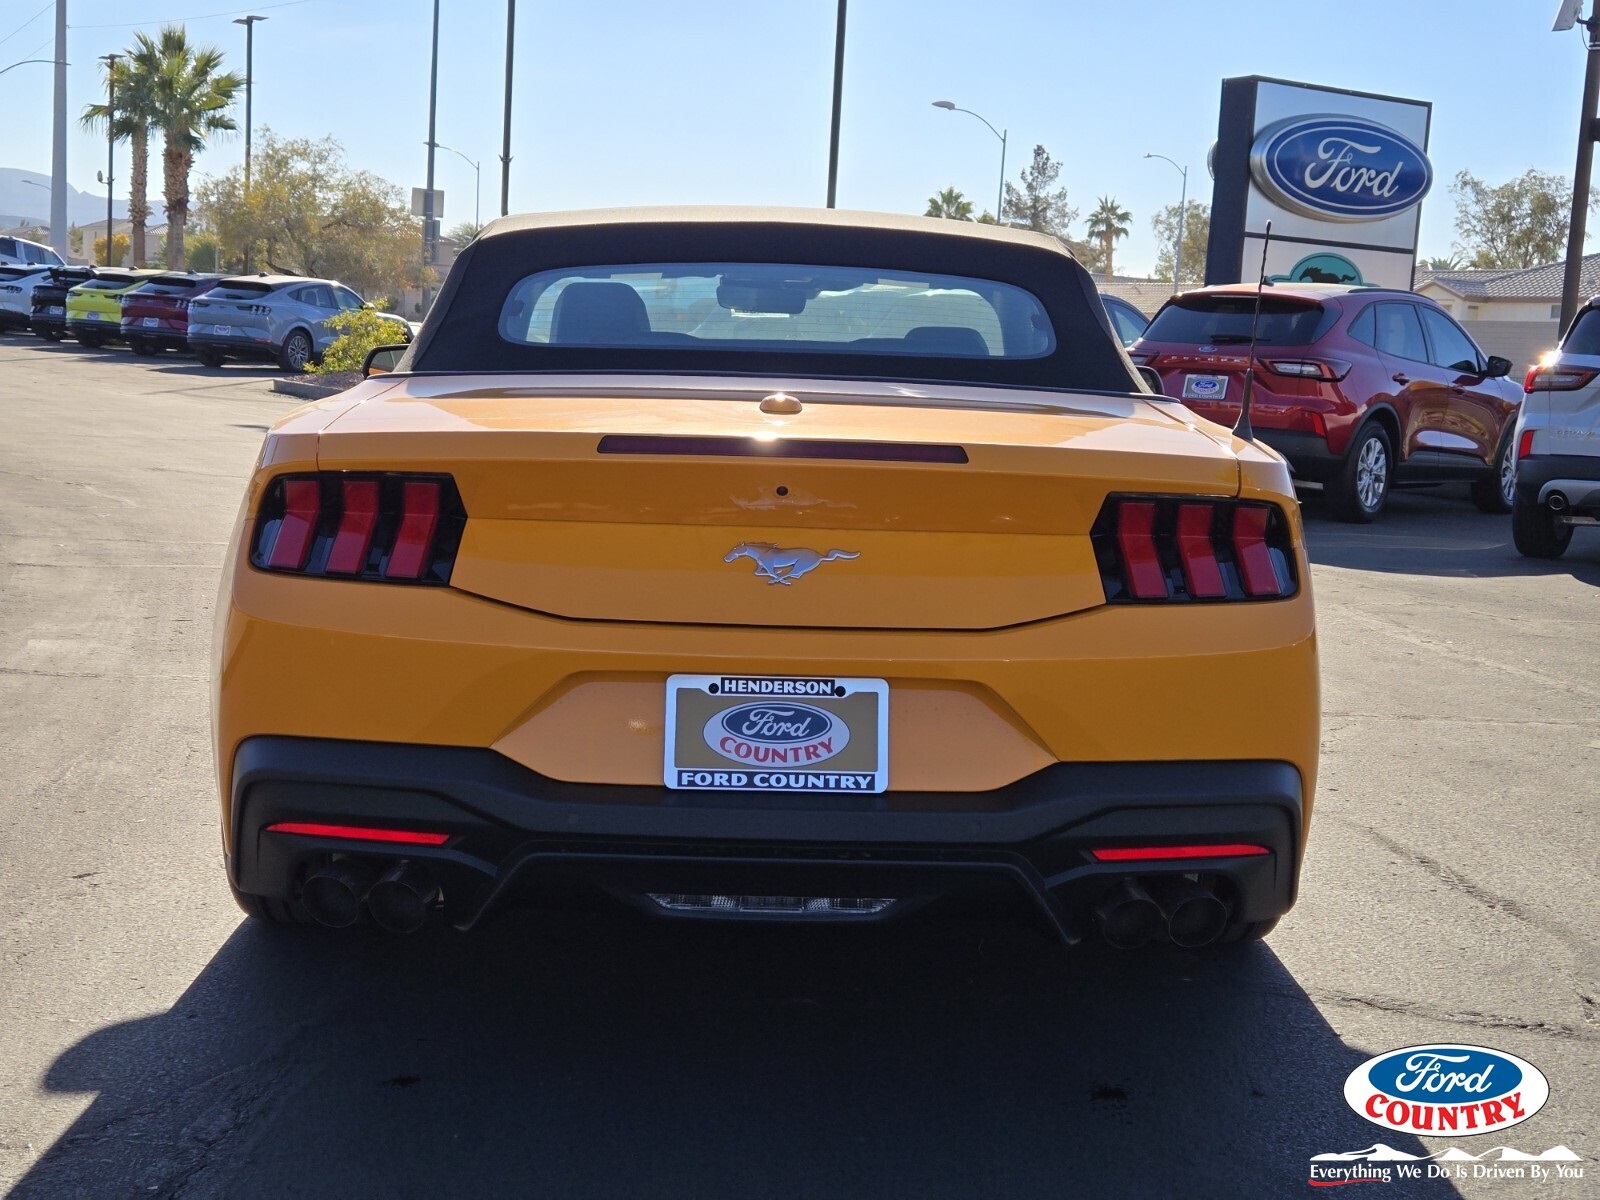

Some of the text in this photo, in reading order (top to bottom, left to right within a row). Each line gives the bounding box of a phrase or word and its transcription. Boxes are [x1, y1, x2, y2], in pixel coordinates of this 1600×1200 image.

[1305, 137, 1403, 197] Ford
[724, 680, 832, 695] HENDERSON
[741, 709, 812, 737] Ford
[719, 736, 834, 763] COUNTRY
[681, 772, 873, 789] FORD COUNTRY
